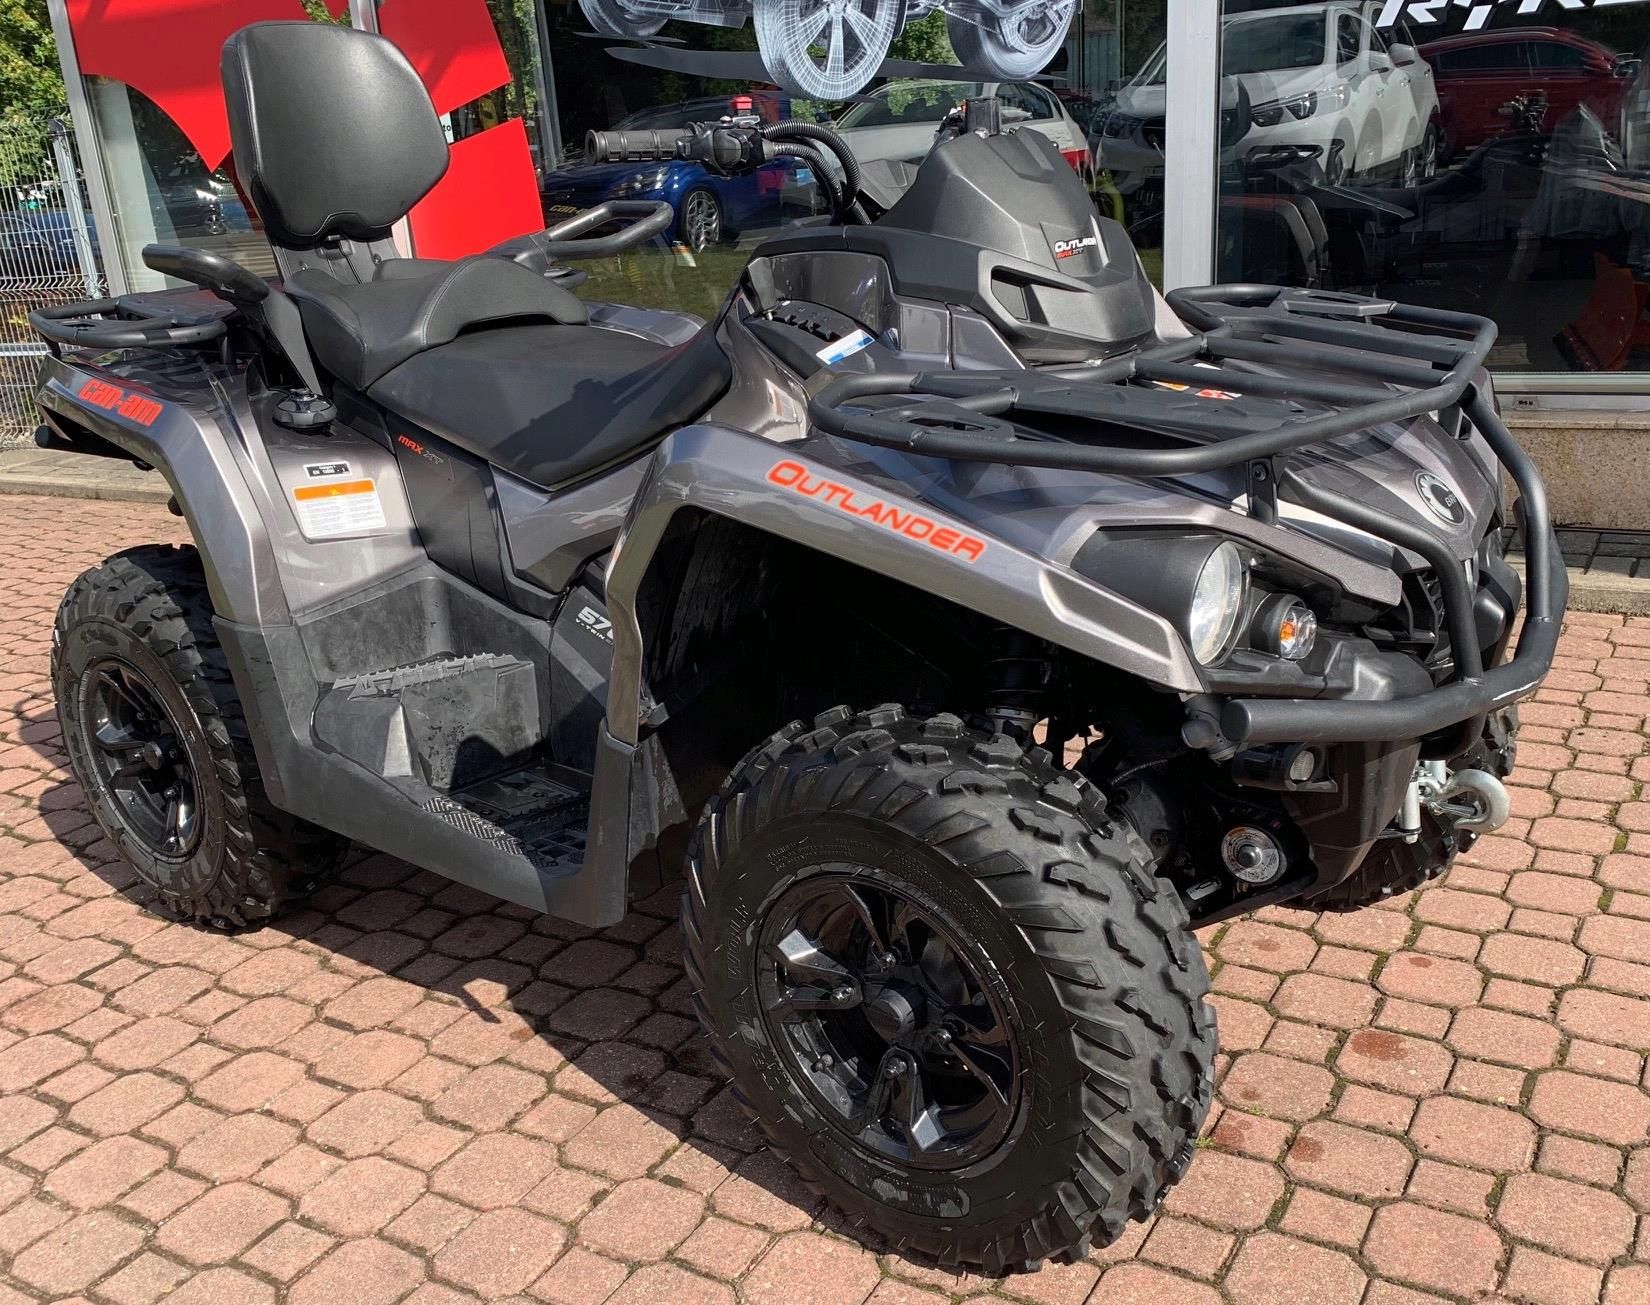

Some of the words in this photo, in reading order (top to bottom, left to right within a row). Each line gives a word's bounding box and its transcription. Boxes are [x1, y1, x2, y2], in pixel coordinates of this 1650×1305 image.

[78, 379, 165, 427] can-am
[397, 434, 424, 455] MAX
[765, 459, 989, 563] OUTLANDER
